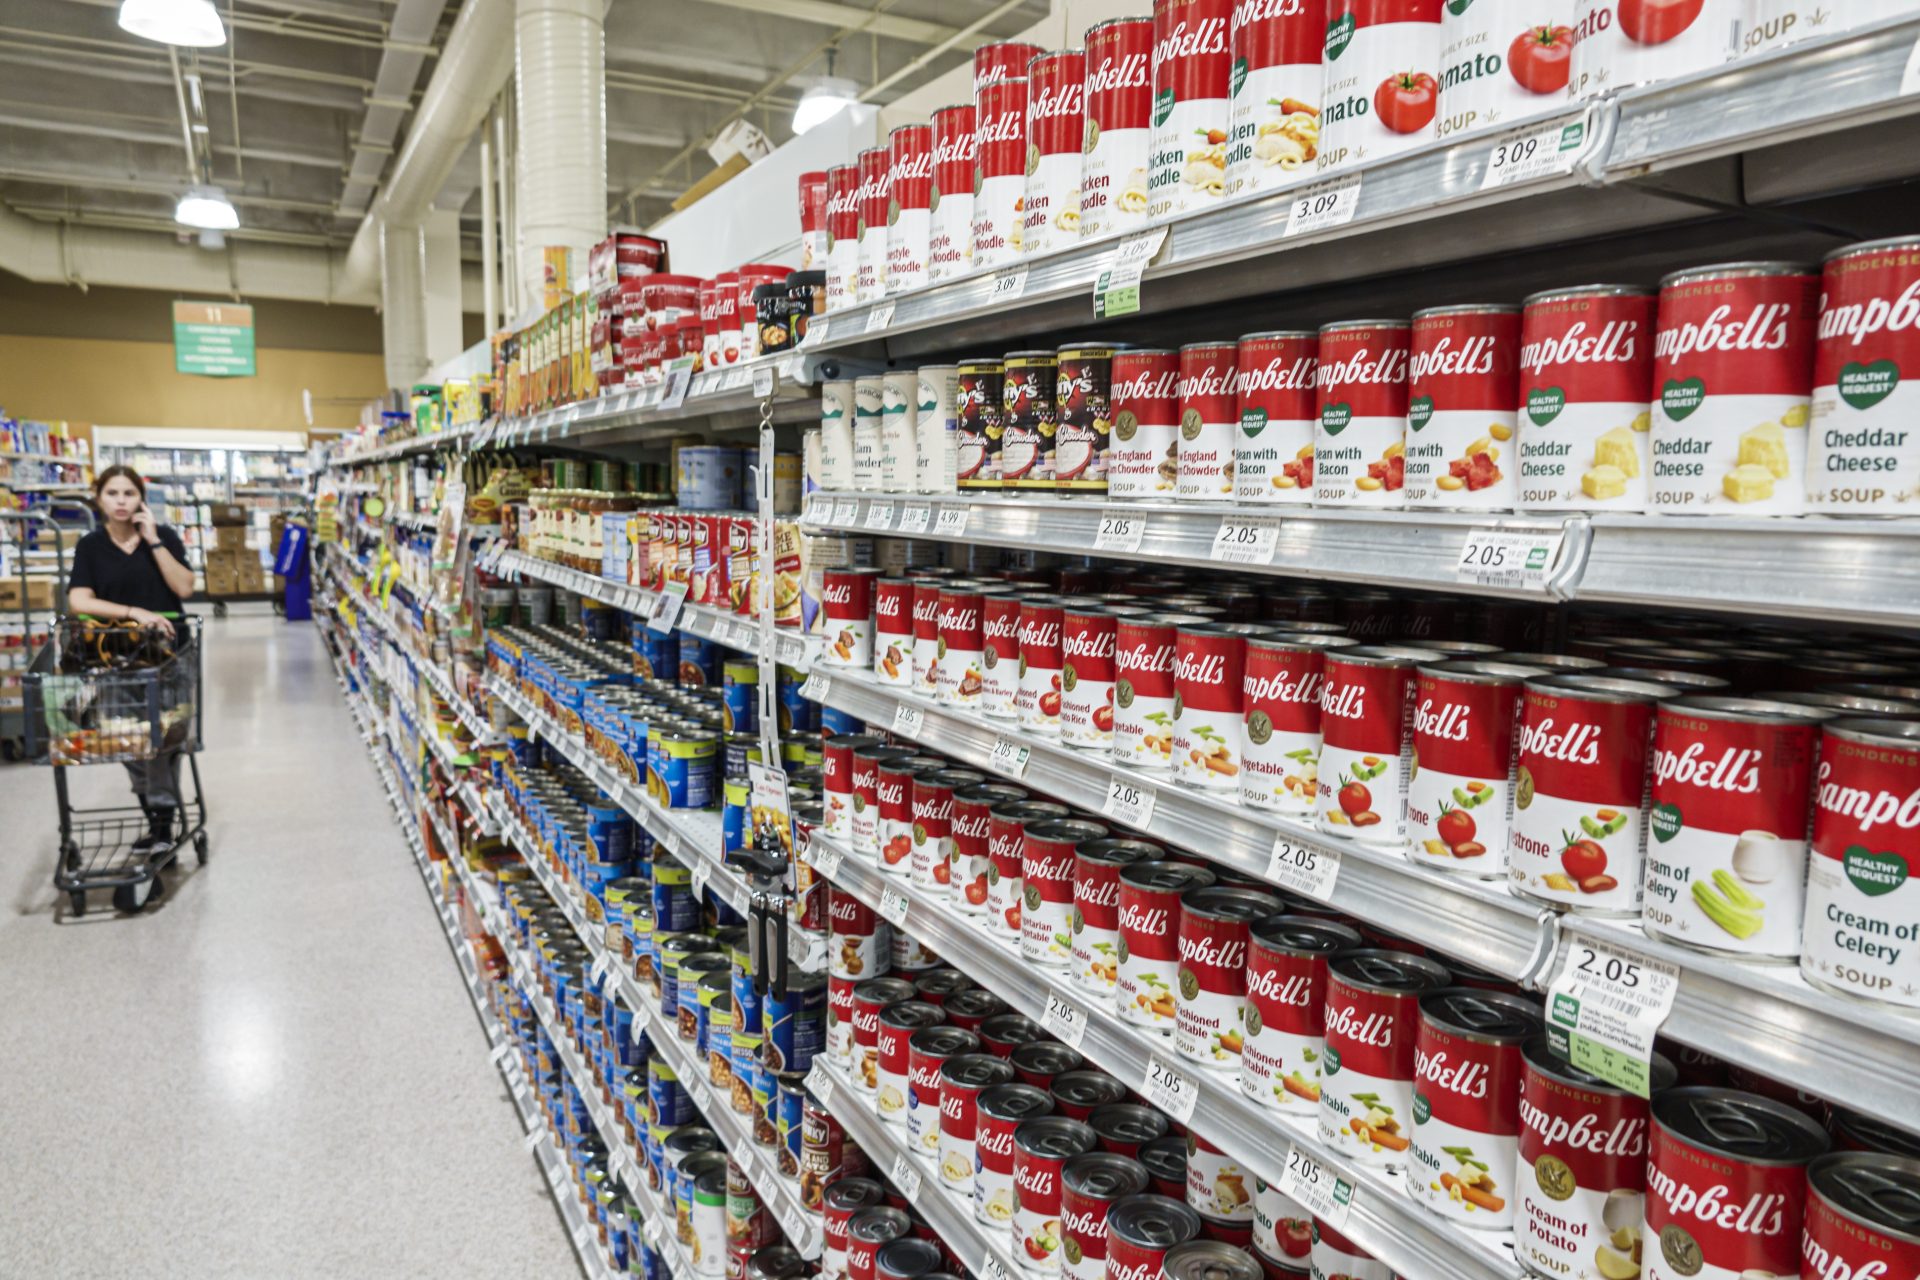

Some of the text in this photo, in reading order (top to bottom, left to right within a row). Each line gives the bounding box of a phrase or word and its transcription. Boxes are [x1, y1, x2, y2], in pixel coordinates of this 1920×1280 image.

[1493, 138, 1538, 168] 3.09
[1298, 194, 1337, 218] 3.09
[1842, 370, 1891, 384] HEALTHY
[1664, 387, 1698, 398] HEALTHY
[1842, 382, 1890, 395] REQUEST
[1529, 395, 1559, 407] HEALTHY
[1664, 397, 1700, 409] REQUEST
[1653, 438, 1712, 455] Cheddar
[1825, 428, 1908, 448] Cheddar
[1118, 449, 1152, 465] England
[1183, 449, 1217, 465] England
[1254, 446, 1277, 460] with
[1343, 446, 1362, 461] with
[1418, 441, 1443, 457] with
[1520, 442, 1573, 457] Cheddar
[1117, 463, 1156, 475] Chowder
[1183, 463, 1221, 477] Chowder
[1240, 463, 1266, 475] Bacon
[1319, 463, 1349, 476] Bacon
[1521, 461, 1565, 477] Cheese
[1653, 461, 1703, 477] Cheese
[1826, 453, 1897, 473] Cheese
[1318, 489, 1346, 500] SOUP
[1522, 489, 1557, 502] SOUP
[1654, 491, 1694, 505] SOUP
[1829, 488, 1885, 503] SOUP
[941, 511, 959, 523] 4.99
[1103, 520, 1130, 537] 2.05
[1222, 526, 1259, 546] 2.05
[1463, 544, 1507, 567] 2.05
[899, 706, 915, 722] 2.05
[994, 741, 1012, 759] 2.05
[1113, 783, 1141, 806] 2.05
[1278, 843, 1318, 872] 2.05
[1848, 854, 1900, 875] HEALTHY
[1673, 864, 1690, 883] of
[1847, 865, 1903, 886] REQUEST
[1826, 902, 1920, 941] Cream of
[1834, 929, 1902, 966] Celery
[1577, 949, 1641, 988] 2.05
[1834, 963, 1893, 990] SOUP
[1601, 980, 1625, 997] CREAM
[1626, 989, 1637, 1001] OF
[1637, 993, 1663, 1010] CELERY
[1050, 998, 1074, 1022] 2.05
[1152, 1064, 1182, 1093] 2.05
[1289, 1151, 1320, 1185] 2.05
[1525, 1196, 1589, 1239] Cream of
[1529, 1218, 1578, 1255] Potato
[1530, 1246, 1571, 1276] SOUP
